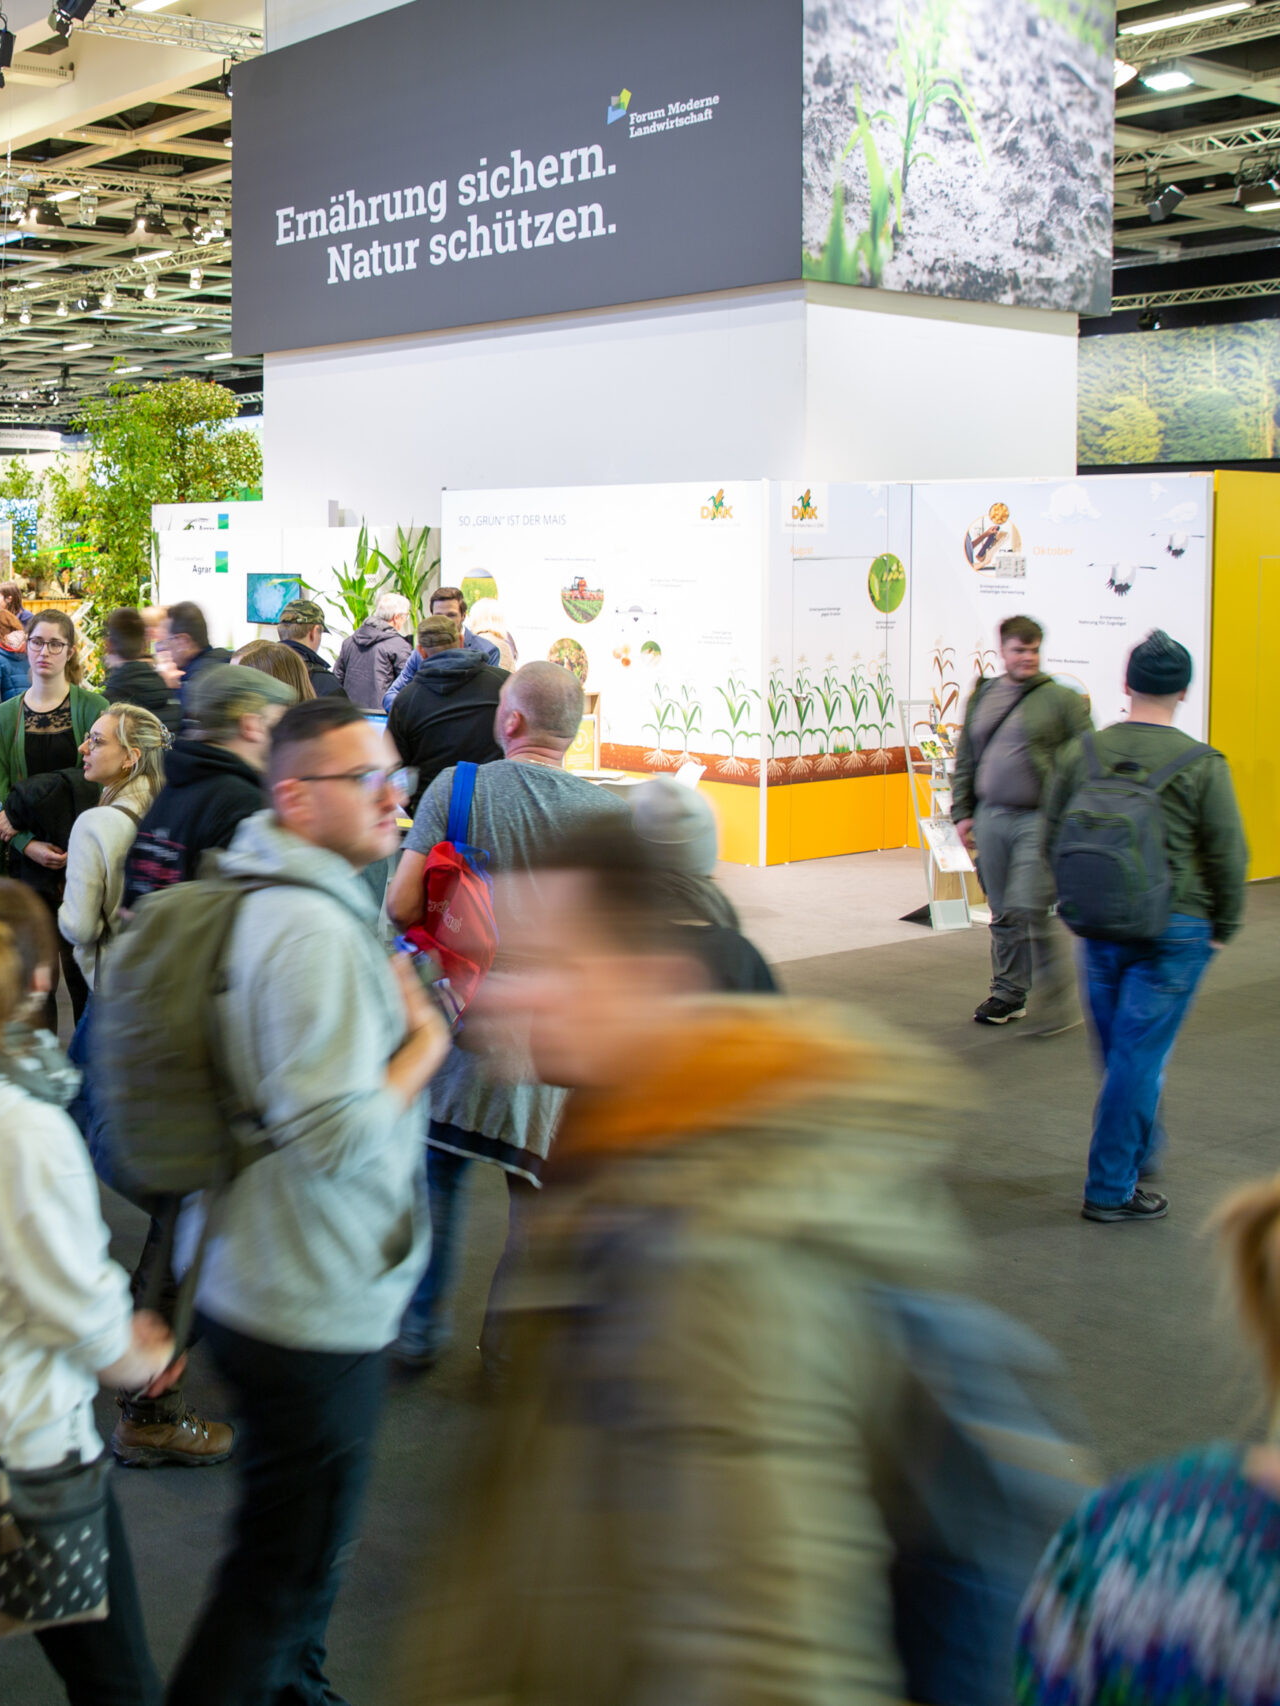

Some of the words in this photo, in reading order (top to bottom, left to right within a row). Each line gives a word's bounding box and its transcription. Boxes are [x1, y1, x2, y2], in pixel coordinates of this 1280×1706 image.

[629, 107, 666, 125] Forum
[667, 94, 720, 116] Moderne
[628, 108, 713, 138] Landwirtschaft
[275, 179, 447, 246] Ernährung
[458, 143, 617, 206] sichern.
[327, 235, 420, 285] Natur
[429, 202, 617, 266] schützen.
[458, 515, 471, 527] SO
[507, 515, 521, 526] IST
[522, 515, 540, 526] DER
[542, 514, 567, 525] MAIS
[701, 506, 733, 519] DMK
[792, 506, 817, 519] DMK
[192, 564, 212, 575] Agrar
